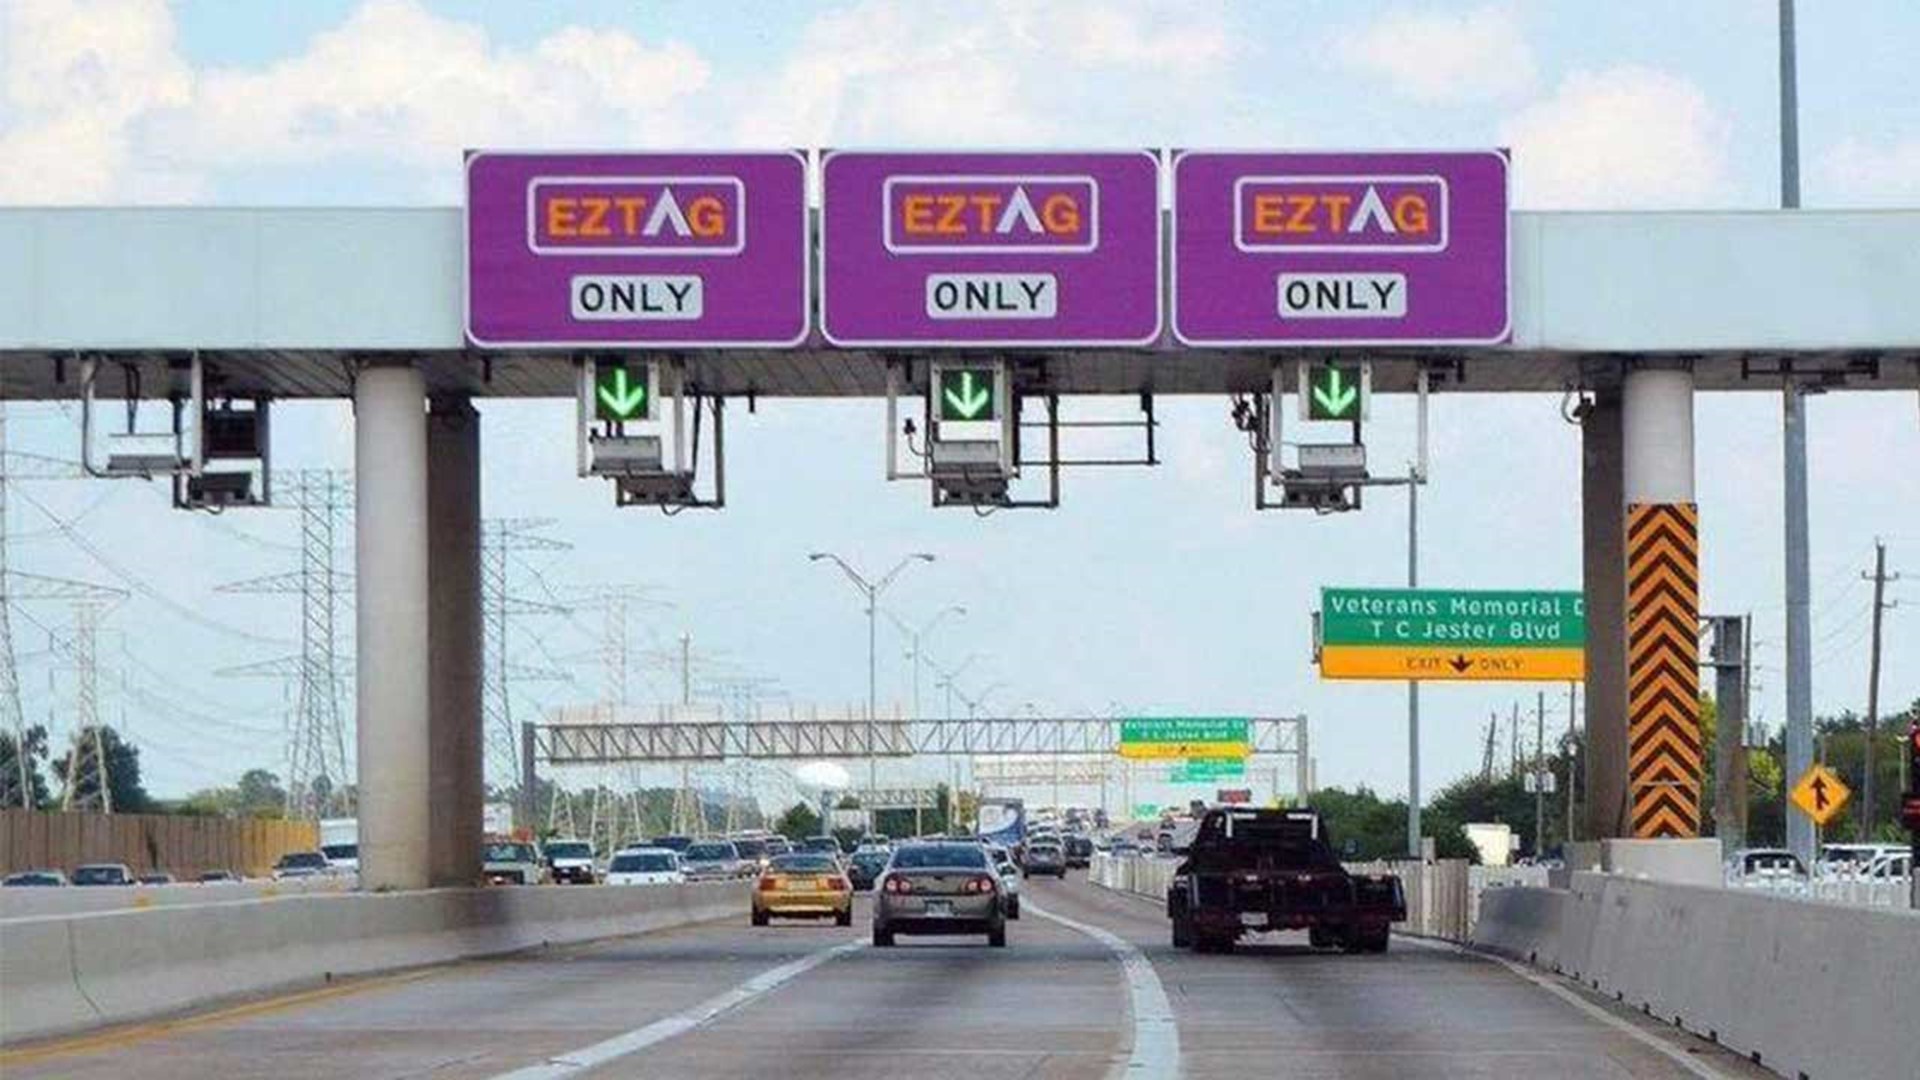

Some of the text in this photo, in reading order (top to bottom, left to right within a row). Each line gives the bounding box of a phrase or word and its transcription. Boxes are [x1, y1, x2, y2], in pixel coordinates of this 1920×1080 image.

[580, 282, 692, 312] ONLY
[934, 281, 1046, 311] ONLY
[1286, 280, 1396, 310] ONLY
[1331, 597, 1437, 615] Veterans
[1450, 598, 1561, 616] Memorial
[1371, 621, 1561, 640] T C Jester Blvd
[1406, 656, 1523, 671] EXIT ONLY
